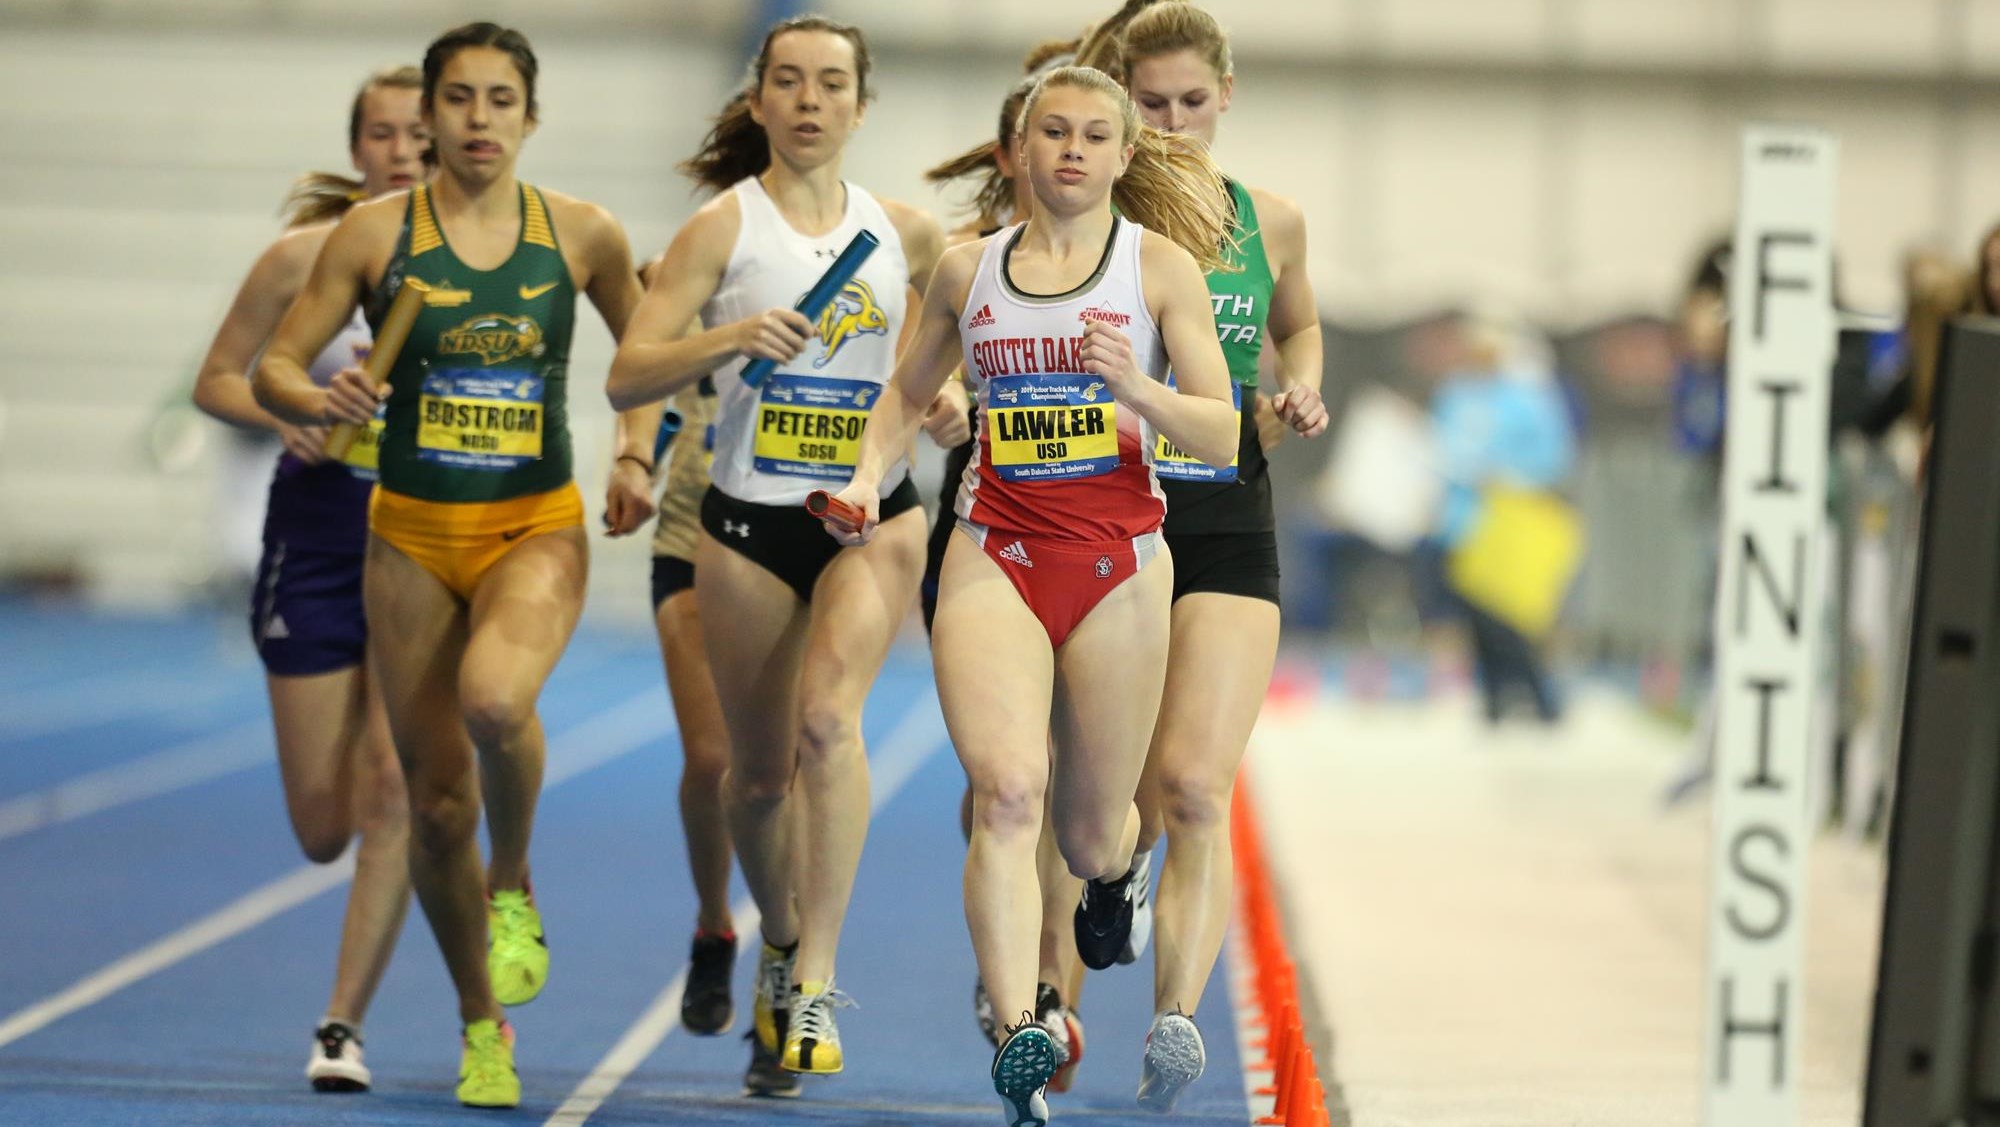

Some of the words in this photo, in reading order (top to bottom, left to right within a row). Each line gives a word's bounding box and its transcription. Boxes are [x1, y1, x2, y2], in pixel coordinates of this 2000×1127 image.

[968, 318, 996, 330] adidas
[1079, 311, 1131, 325] SUMMIT
[973, 338, 1039, 379] SOUTH
[1042, 336, 1096, 375] DAK
[426, 400, 536, 433] BOSTROM
[997, 407, 1105, 441] LAWLER
[798, 443, 837, 460] SDSU
[1036, 442, 1067, 460] USD
[1163, 441, 1192, 458] UN
[1066, 463, 1095, 472] University
[1188, 467, 1216, 478] University
[999, 550, 1033, 568] adidas
[1717, 230, 1816, 1088] FINISH
